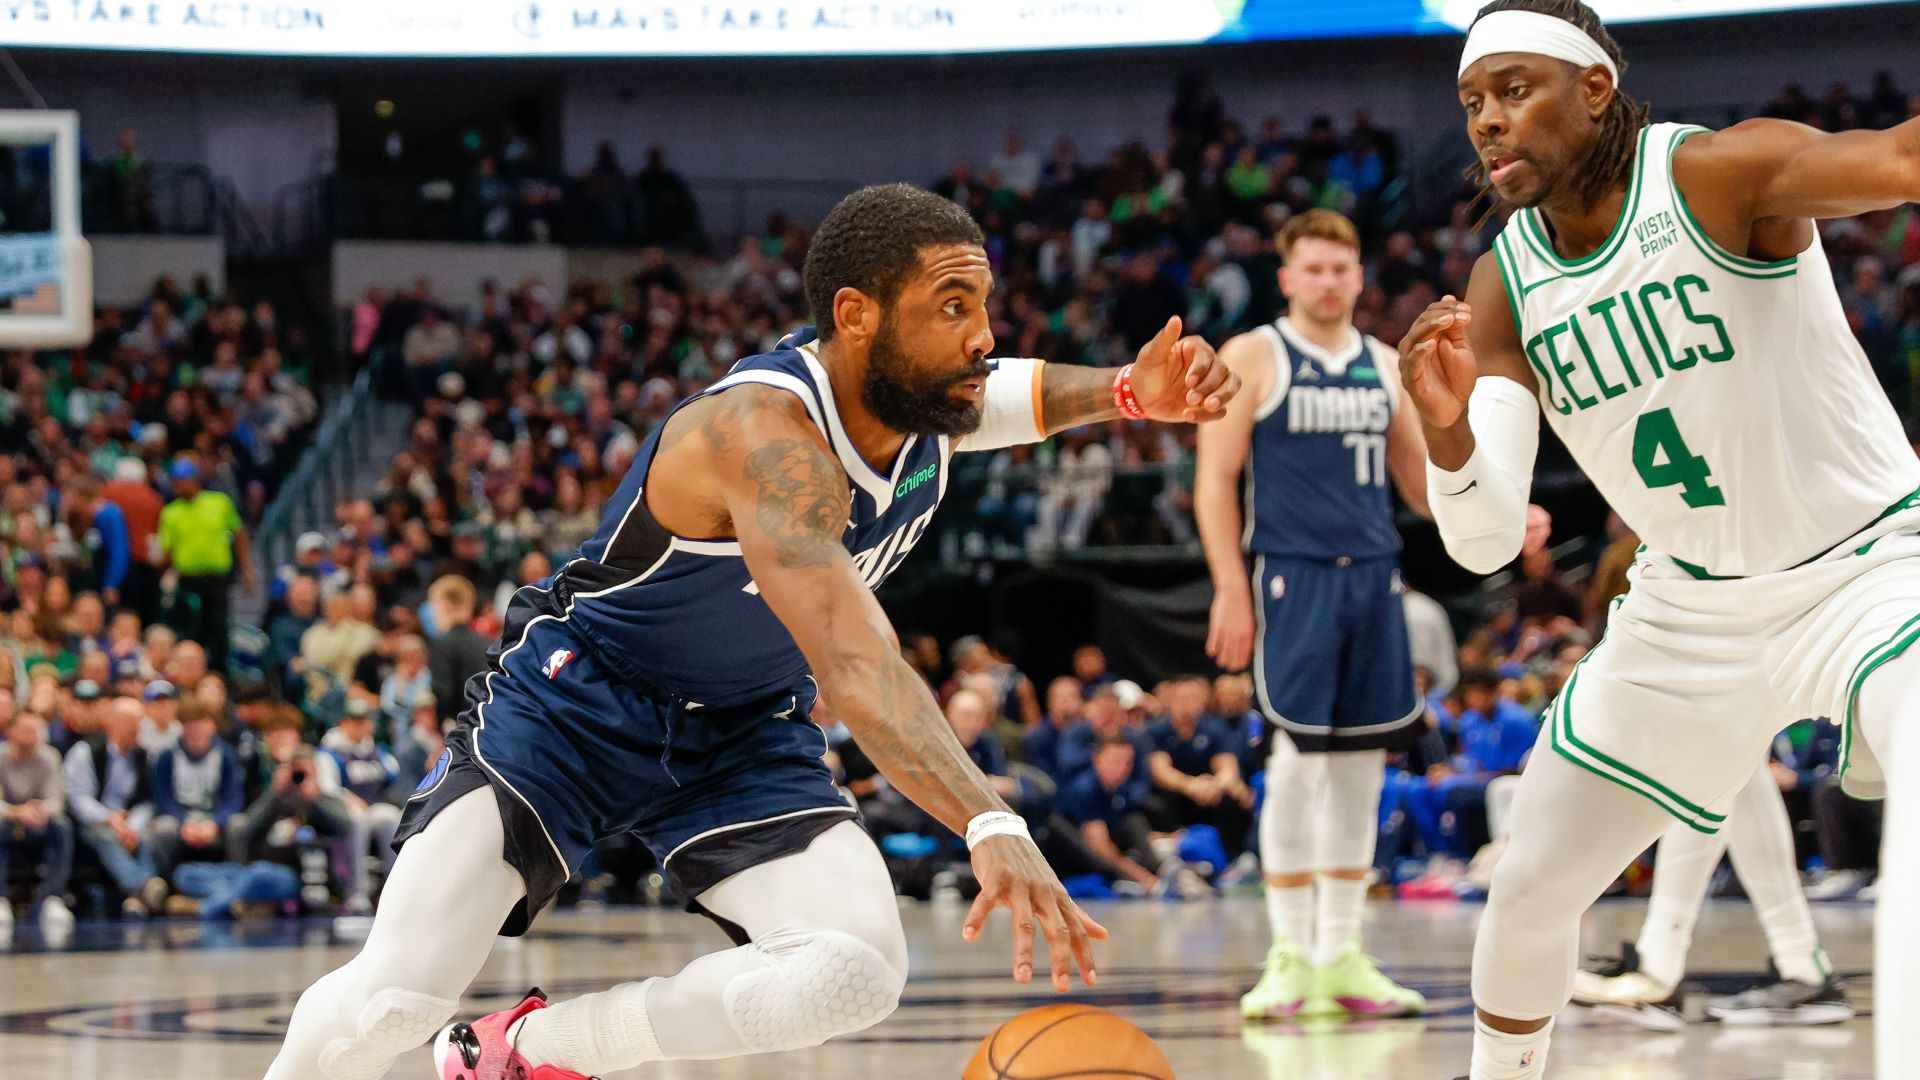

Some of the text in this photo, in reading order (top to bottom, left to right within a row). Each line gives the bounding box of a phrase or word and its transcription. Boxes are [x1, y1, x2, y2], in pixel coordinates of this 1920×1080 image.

[1634, 210, 1675, 243] VISTA
[1641, 229, 1678, 259] PRINT
[1526, 274, 1735, 415] CELTICS
[1287, 385, 1390, 434] MAVS
[896, 463, 936, 498] chime
[1342, 432, 1387, 487] 77
[1632, 407, 1726, 509] 4
